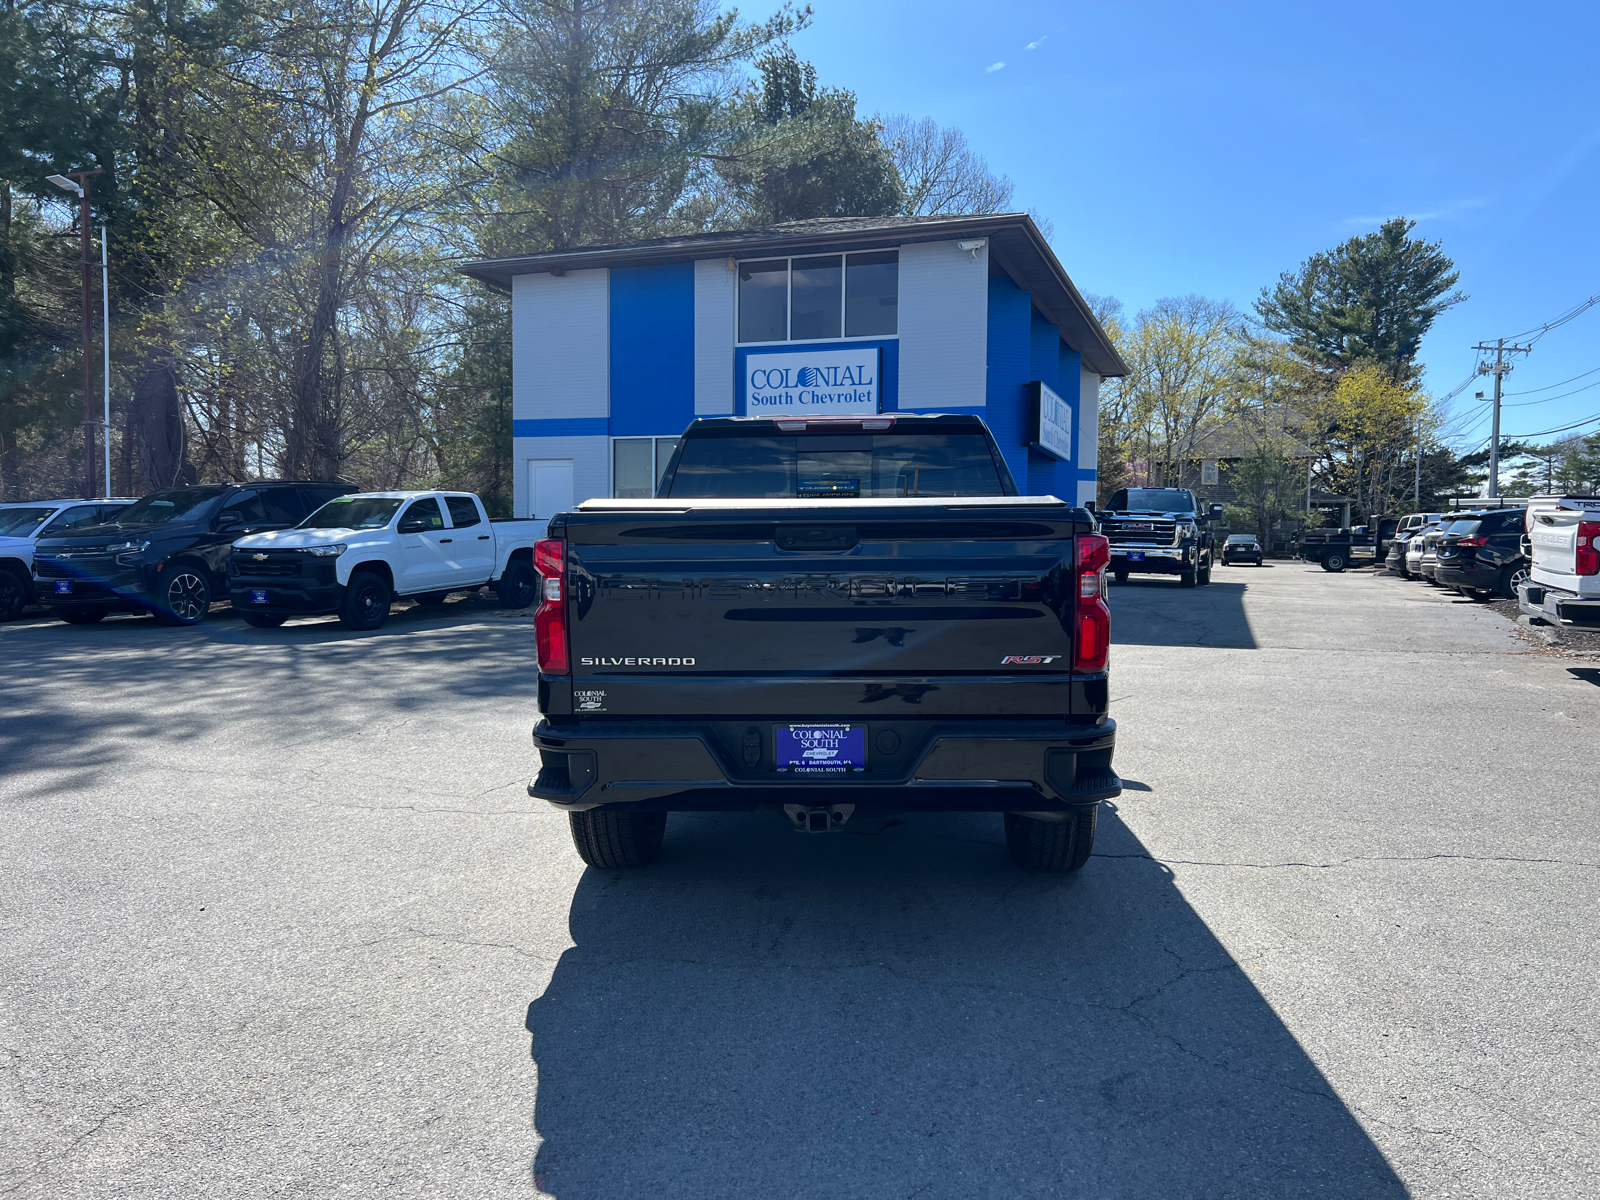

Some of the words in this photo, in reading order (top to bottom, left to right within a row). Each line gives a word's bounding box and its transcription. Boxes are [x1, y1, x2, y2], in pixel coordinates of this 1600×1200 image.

[751, 365, 873, 390] COLONIAL
[752, 391, 793, 406] South
[798, 389, 873, 405] Chevrolet
[600, 577, 1037, 601] CHEVROLET
[581, 657, 696, 666] SILVERADO
[1001, 655, 1062, 664] RST
[792, 730, 847, 739] COLONIAL
[800, 739, 839, 748] SOUTH
